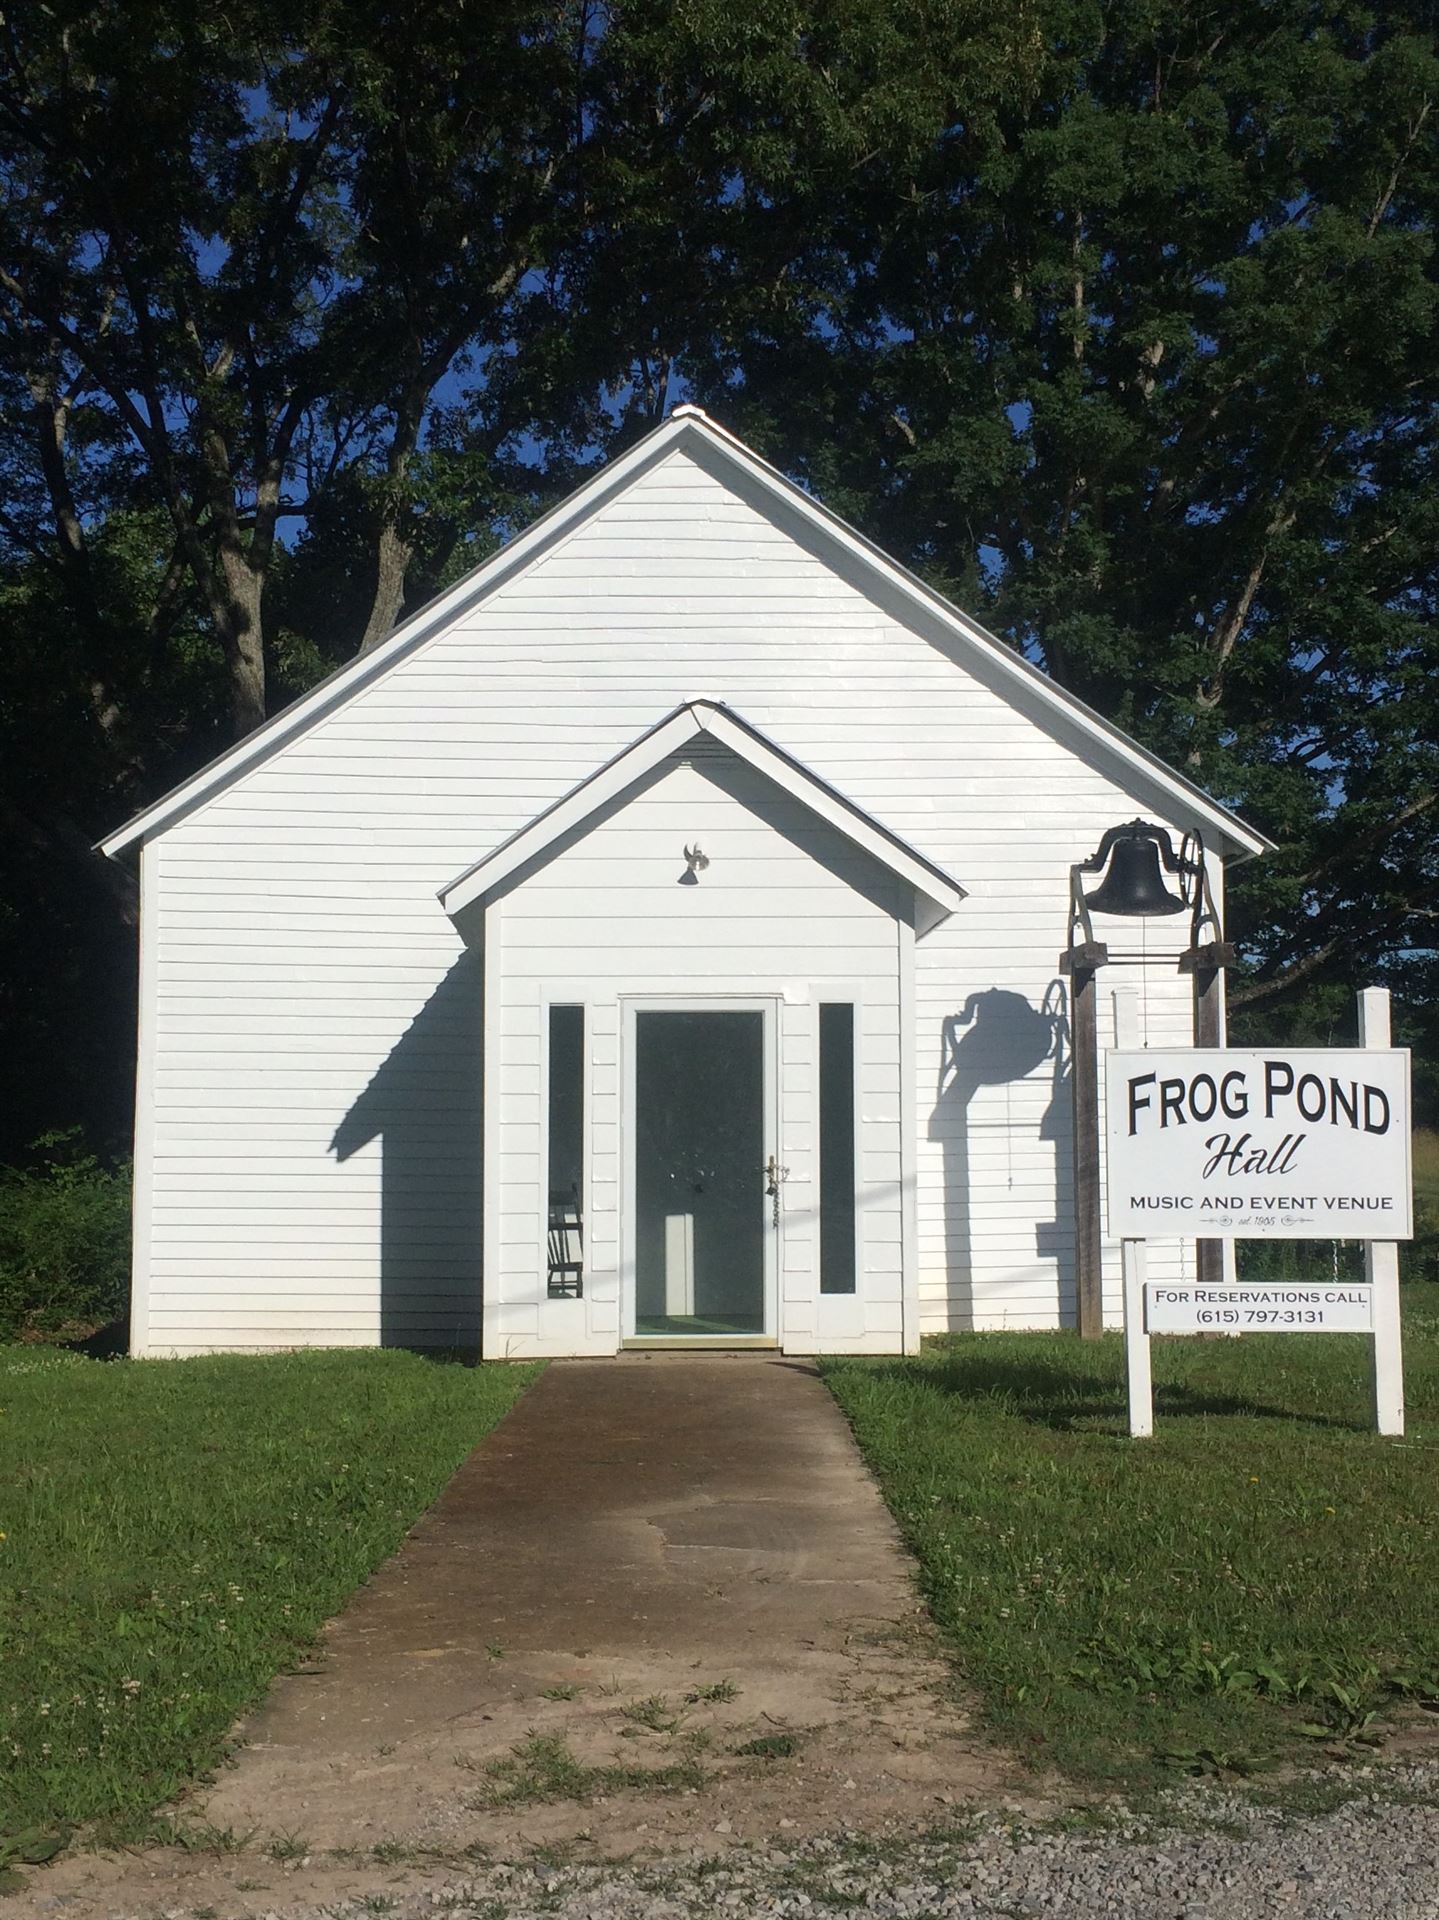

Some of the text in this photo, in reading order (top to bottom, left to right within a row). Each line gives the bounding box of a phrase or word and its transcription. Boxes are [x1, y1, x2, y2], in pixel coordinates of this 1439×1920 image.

[1127, 1061, 1390, 1137] FROG POND
[1202, 1133, 1307, 1179] Hall
[1130, 1196, 1393, 1209] MUSIC AND EVENT VENUE
[1155, 1290, 1368, 1303] FOR RESERVATIONS CALL
[1196, 1310, 1324, 1324] (615) 797-3131
